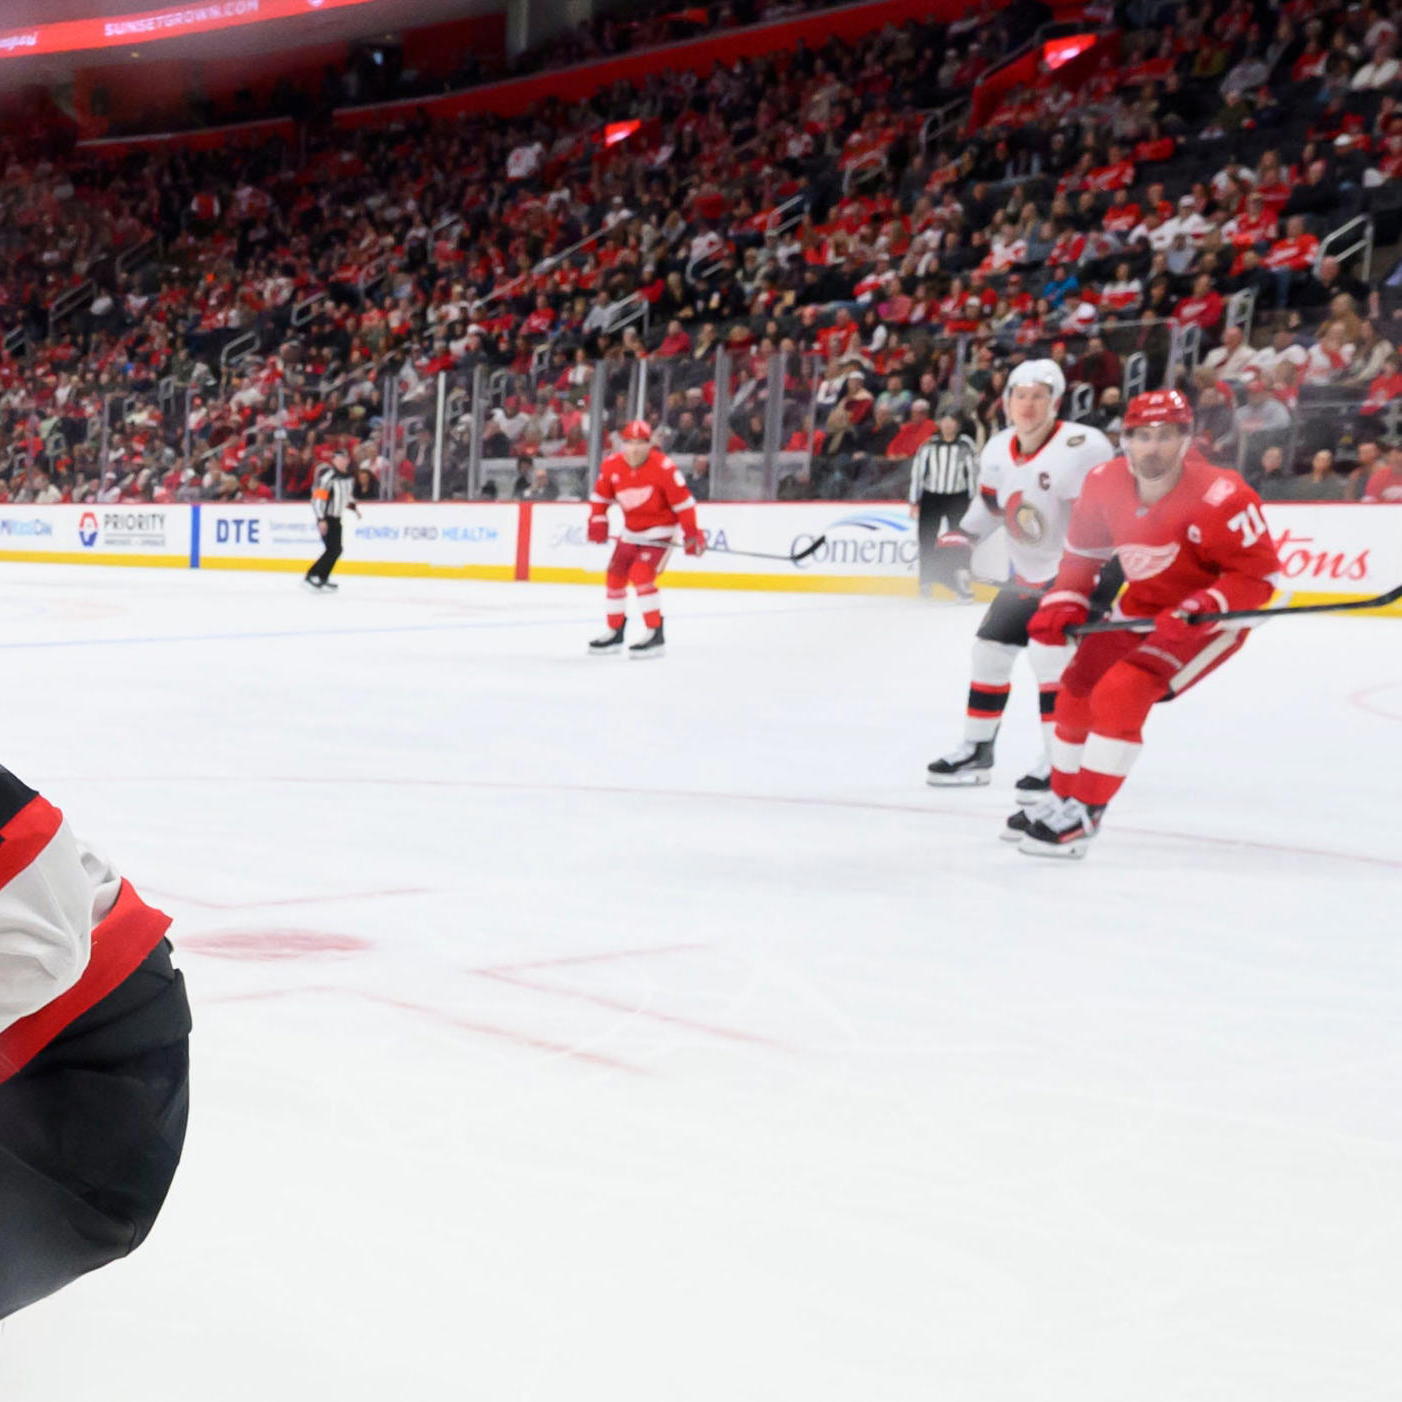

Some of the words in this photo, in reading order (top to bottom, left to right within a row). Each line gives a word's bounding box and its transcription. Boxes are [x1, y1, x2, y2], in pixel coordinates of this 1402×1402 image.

[1037, 472, 1051, 491] C
[103, 513, 166, 531] PRIORITY
[216, 519, 261, 543] DTE
[403, 526, 439, 540] FORD
[1227, 503, 1266, 548] 71
[790, 533, 919, 570] Comeric
[1272, 529, 1372, 580] tons
